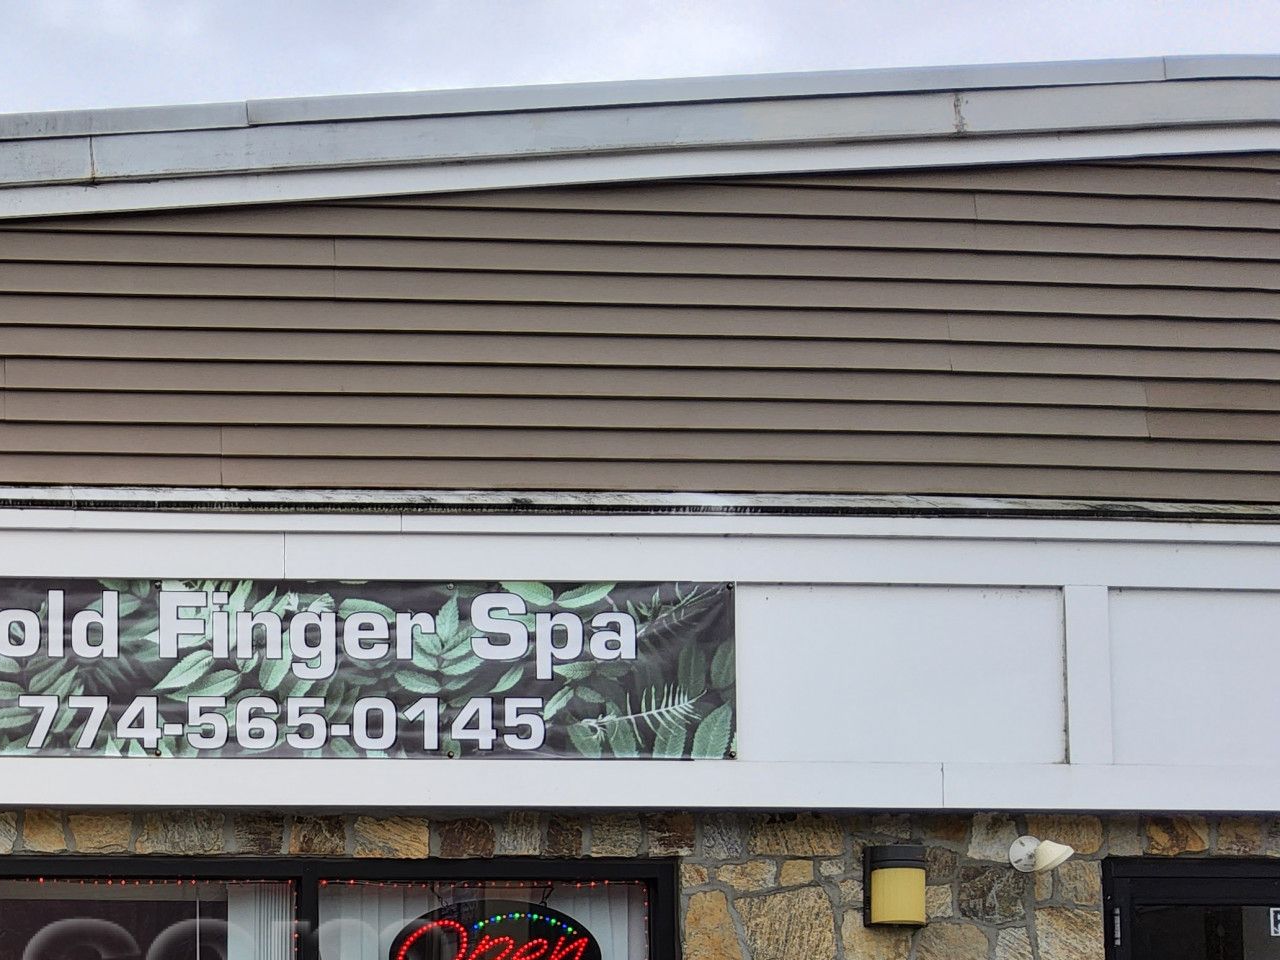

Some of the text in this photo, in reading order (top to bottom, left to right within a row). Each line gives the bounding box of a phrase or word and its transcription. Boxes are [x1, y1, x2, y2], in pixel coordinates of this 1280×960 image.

[158, 590, 436, 680] Finger
[470, 591, 638, 680] Spa
[18, 695, 546, 751] 774-565-0145
